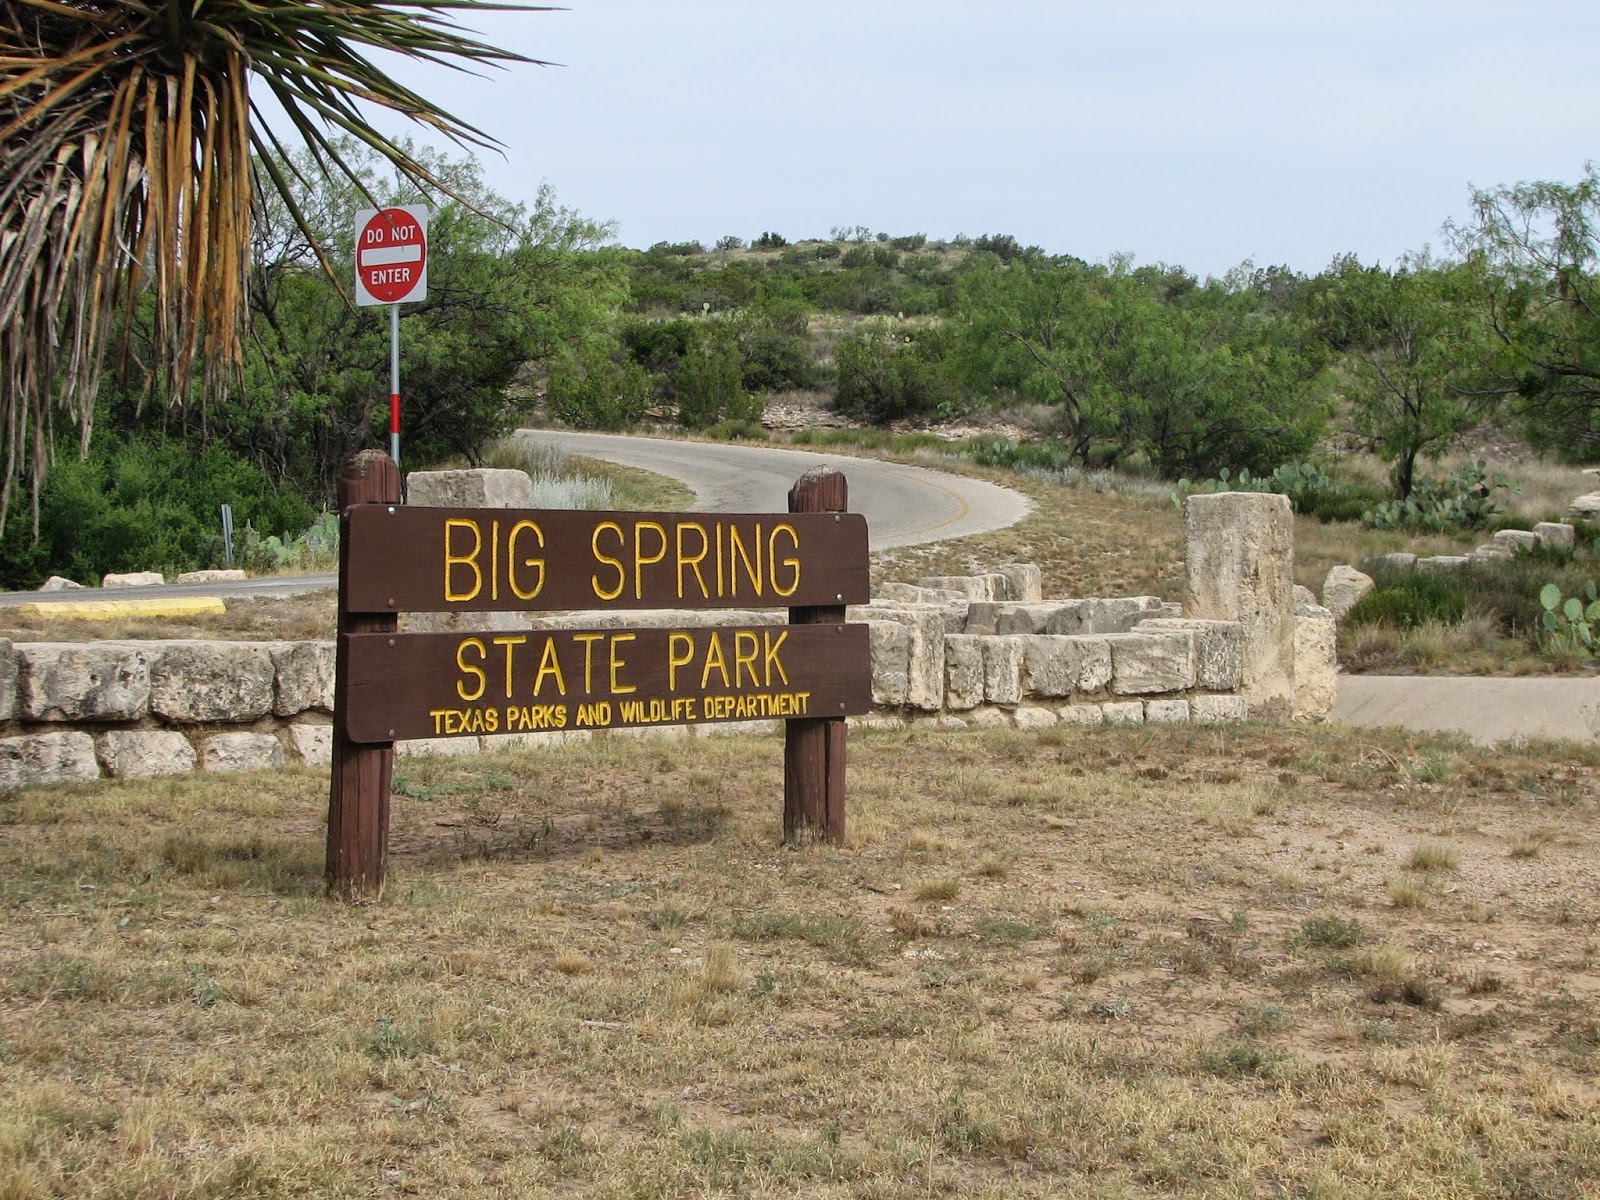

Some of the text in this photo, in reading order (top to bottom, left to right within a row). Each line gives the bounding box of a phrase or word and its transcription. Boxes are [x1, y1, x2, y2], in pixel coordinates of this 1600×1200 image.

[367, 225, 415, 243] DO NOT
[371, 267, 410, 285] ENTER
[444, 518, 801, 602] BIG SPRING
[456, 629, 789, 701] STATE PARK
[429, 691, 811, 735] TEXAS PARKS AND WILDLIFE DEPARTMENT
